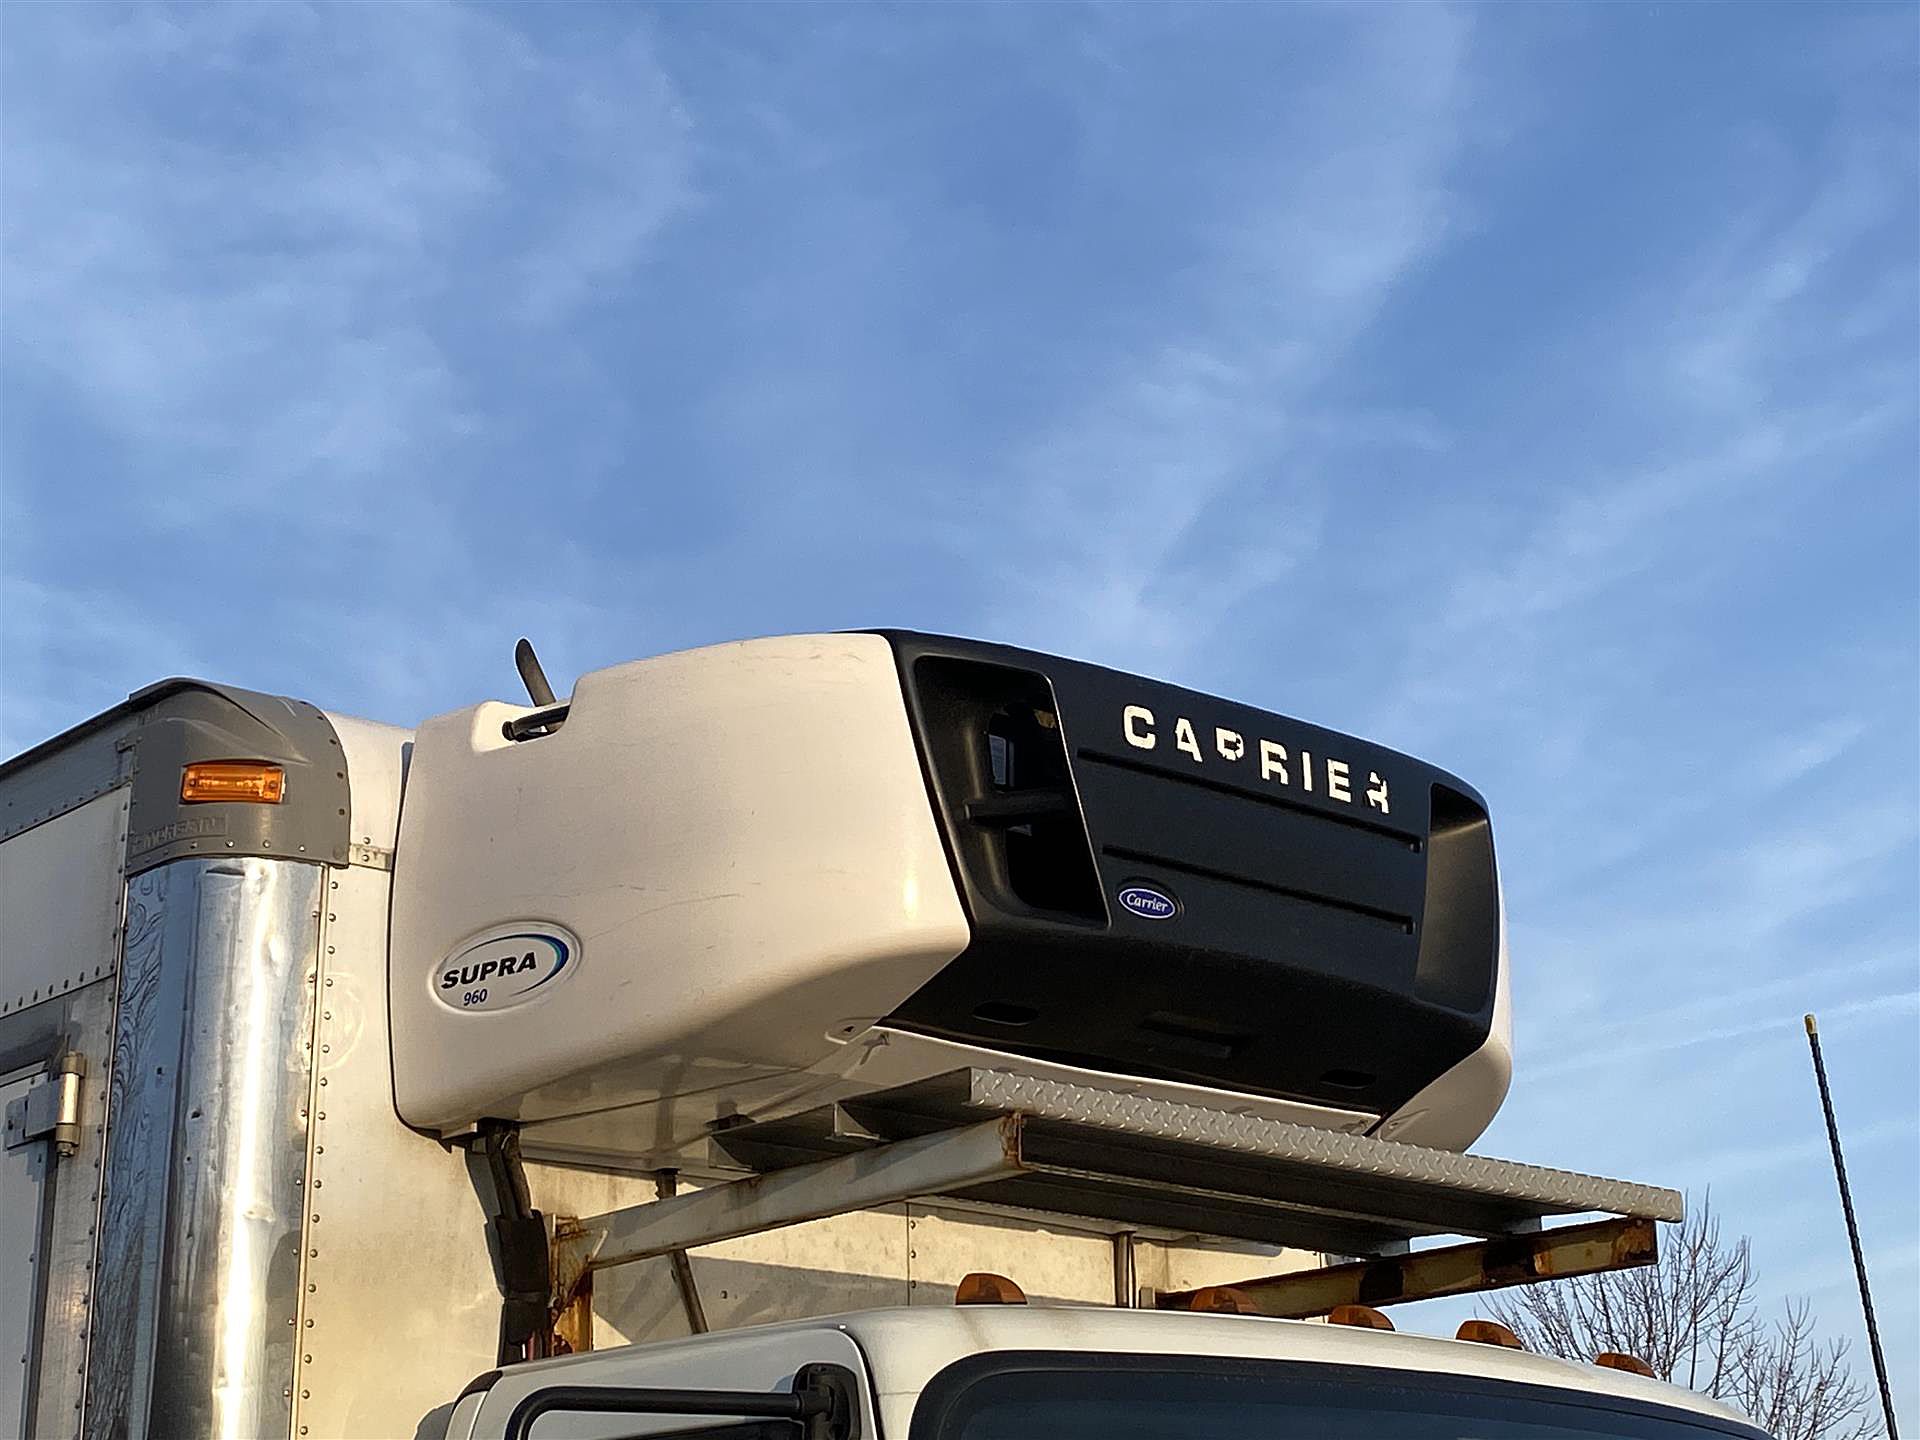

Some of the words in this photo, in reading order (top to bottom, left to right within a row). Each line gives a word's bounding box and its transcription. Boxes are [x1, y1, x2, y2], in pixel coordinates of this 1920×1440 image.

[1127, 893, 1168, 912] Carrier
[441, 952, 537, 989] SUPRA
[463, 988, 488, 1006] 960
